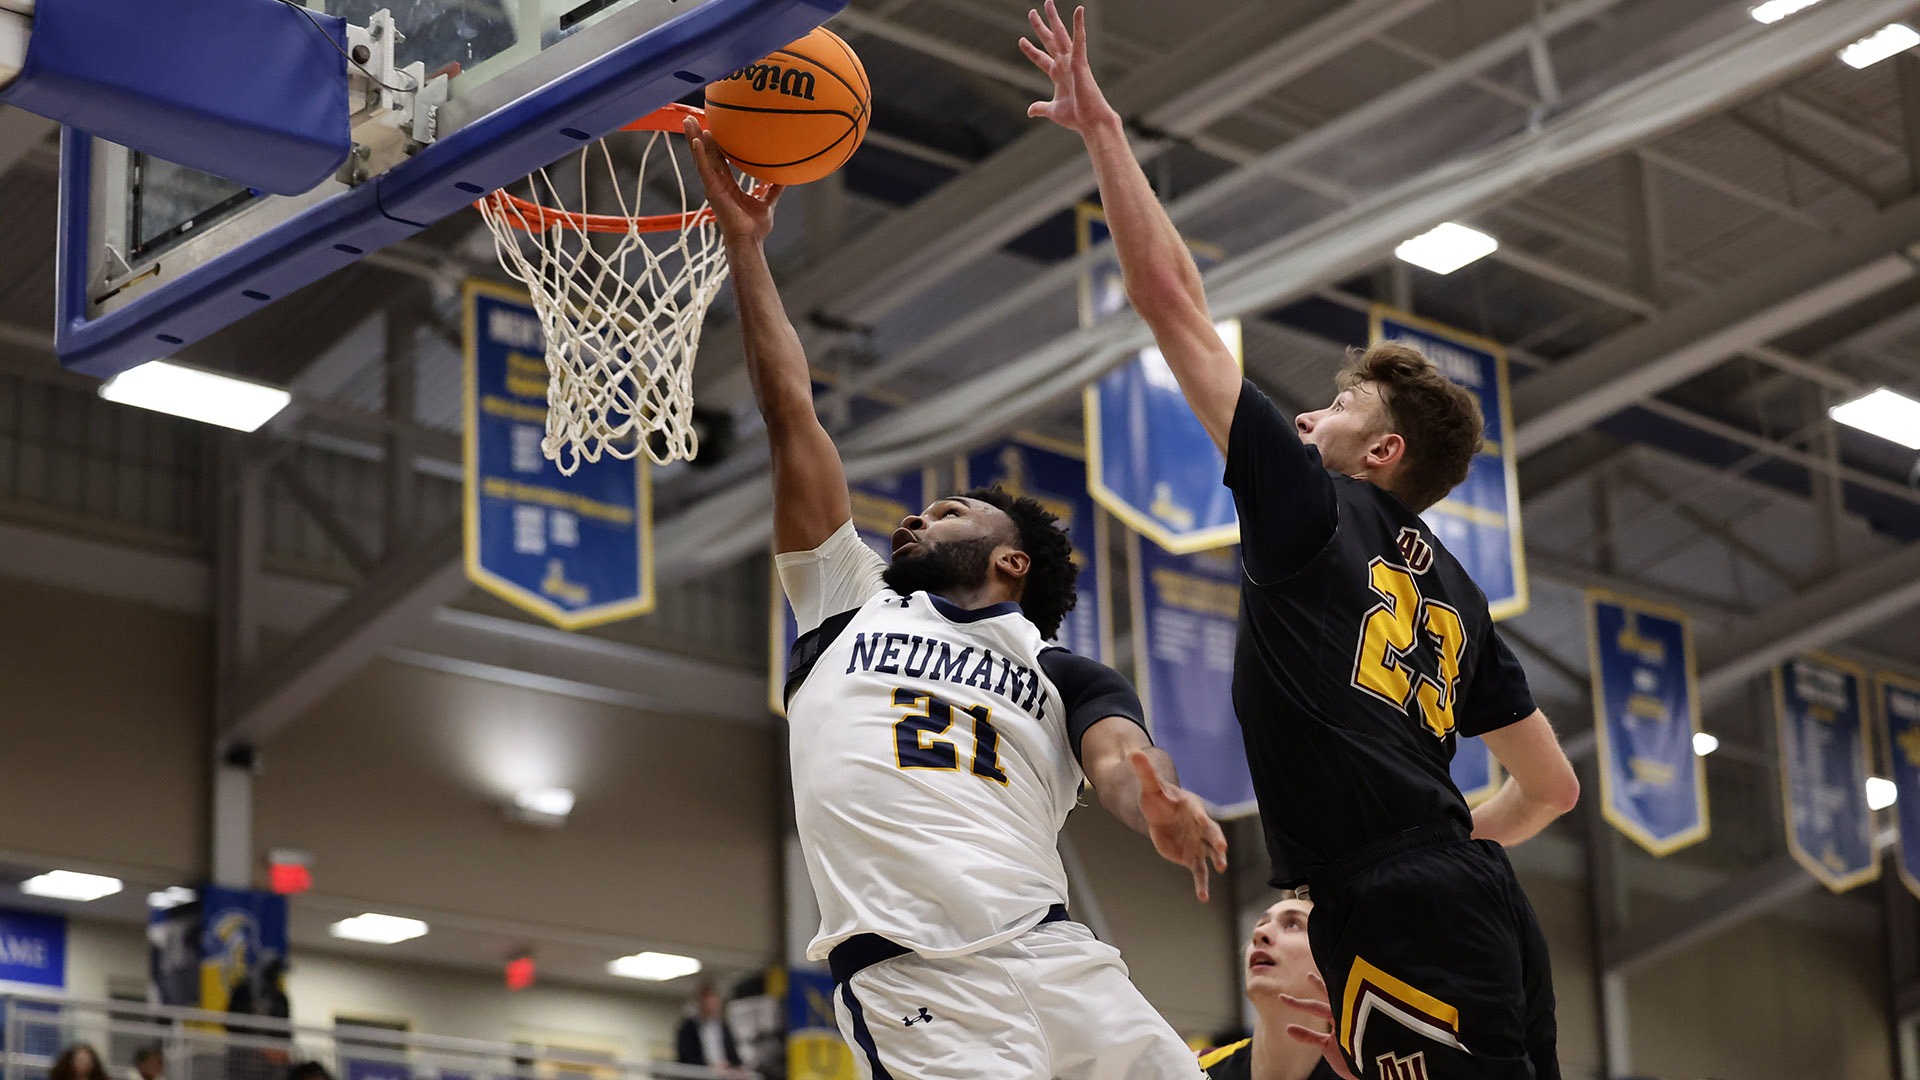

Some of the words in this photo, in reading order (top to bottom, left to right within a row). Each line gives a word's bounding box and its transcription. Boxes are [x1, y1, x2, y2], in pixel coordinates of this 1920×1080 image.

[717, 63, 815, 101] Wilso
[1396, 526, 1433, 575] AU
[1350, 555, 1467, 742] 23
[891, 687, 1010, 787] 21
